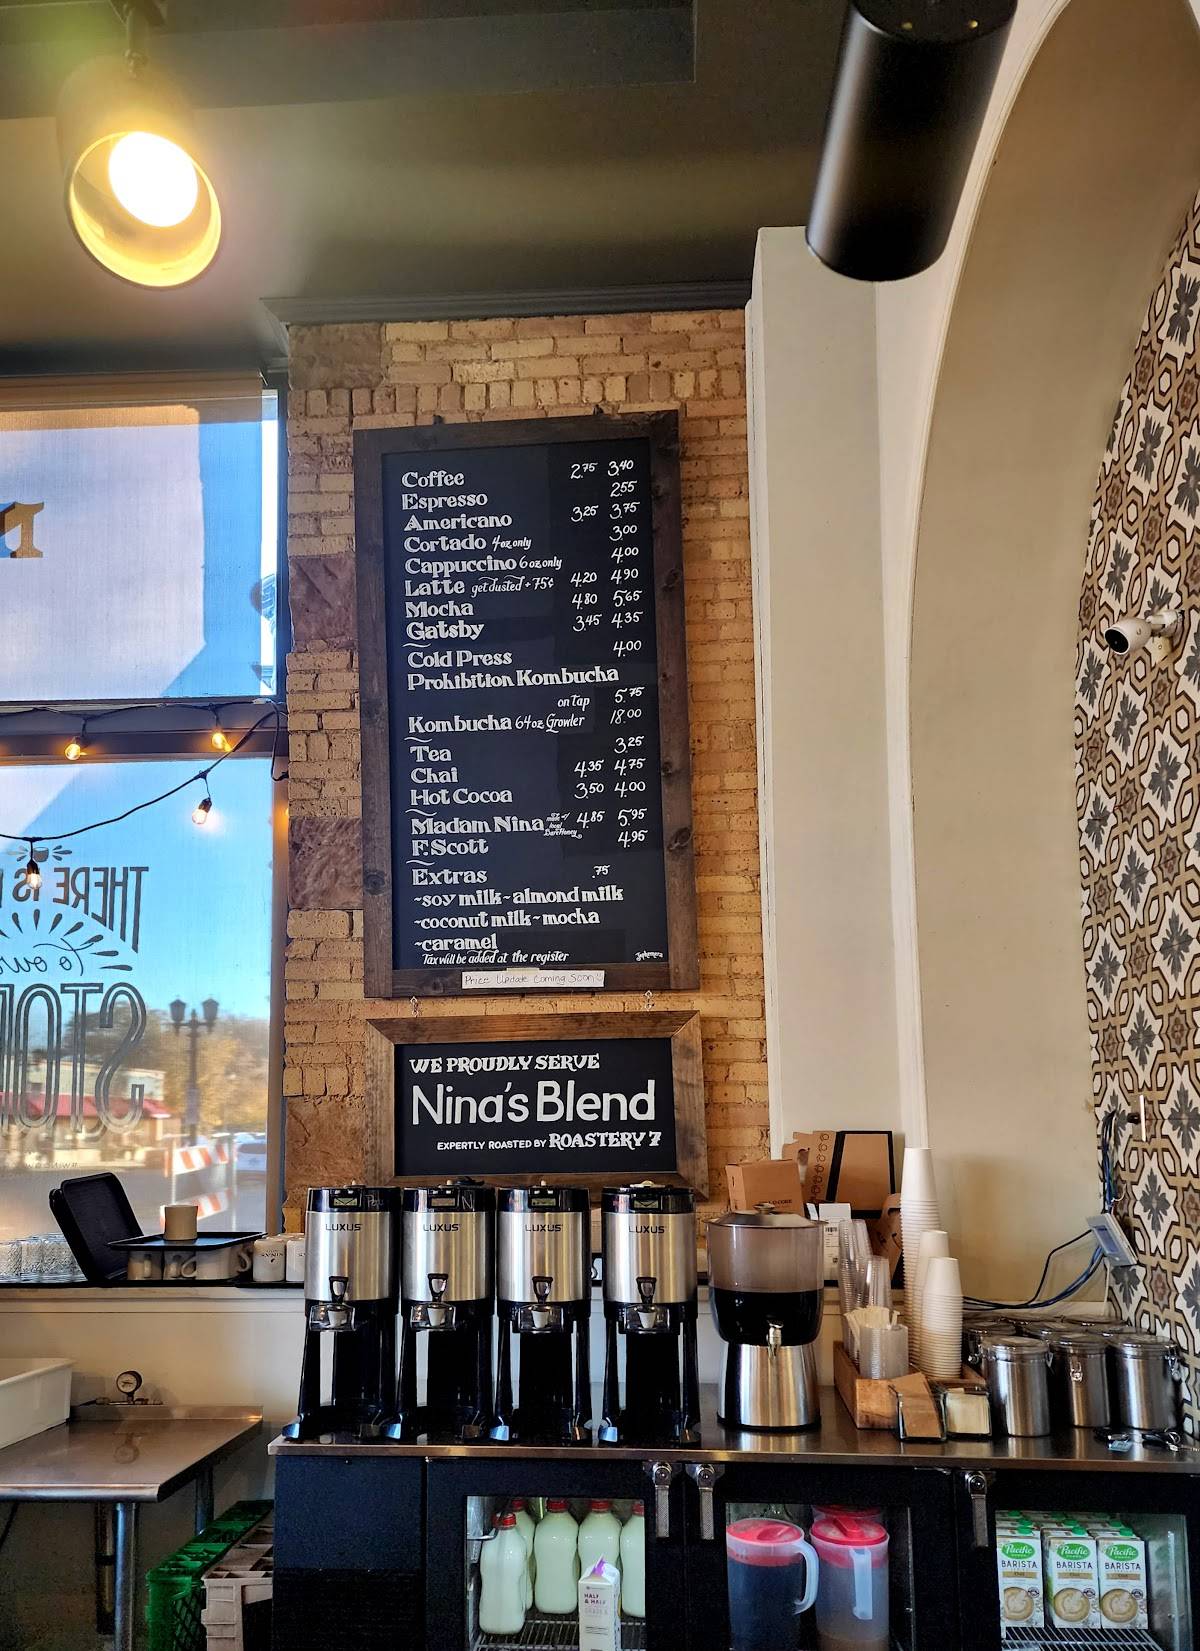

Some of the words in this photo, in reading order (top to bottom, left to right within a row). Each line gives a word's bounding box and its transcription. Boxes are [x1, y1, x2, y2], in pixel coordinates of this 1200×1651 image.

[401, 470, 465, 488] Coffee
[571, 463, 598, 479] 2.75
[608, 460, 634, 476] 3.40
[401, 493, 489, 512] Espresso
[610, 480, 638, 497] 2.55
[404, 514, 513, 531] Americano
[571, 505, 599, 522] 3.25
[610, 501, 641, 519] 3.75
[404, 534, 487, 553] Cortado
[513, 537, 532, 550] only
[608, 525, 638, 541] 3.00
[404, 555, 517, 578] Cappuccino
[542, 556, 563, 570] only
[611, 547, 639, 564] 4.00
[404, 580, 466, 597] Latte
[471, 581, 489, 598] get
[479, 575, 525, 592] dusted
[571, 571, 598, 588] 4.20
[405, 601, 474, 618] Mocha
[572, 593, 598, 610] 4.80
[613, 590, 643, 608] 5.65
[406, 620, 485, 640] Gatsby
[572, 614, 603, 632] 3.45
[611, 612, 644, 629] 4.35
[407, 651, 452, 668] Cold
[456, 650, 513, 667] Press
[613, 641, 642, 657] 4.00
[407, 671, 515, 690] Prohibition
[516, 666, 620, 687] Kombucha
[557, 698, 570, 707] on
[614, 686, 645, 703] 5.75
[408, 714, 512, 733] Kombucha
[545, 713, 585, 733] Growler
[609, 708, 642, 725] 18.00
[410, 746, 452, 762] Tea
[614, 736, 645, 753] 3.25
[410, 767, 459, 783] Chai
[574, 760, 605, 778] 4.35
[614, 758, 646, 775] 4.75
[410, 789, 450, 806] Hot
[452, 788, 513, 804] Cocoa
[575, 783, 605, 799] 3.50
[614, 781, 646, 798] 4.00
[411, 818, 492, 835] Madam
[494, 816, 544, 833] Nina
[576, 811, 606, 829] 4.85
[618, 808, 648, 826] 5.95
[411, 839, 428, 856] F.
[430, 838, 489, 855] Scott
[618, 830, 648, 848] 4.95
[412, 868, 488, 885] Extras
[458, 889, 503, 906] milk
[581, 885, 624, 902] milk
[491, 910, 532, 927] milk
[421, 953, 439, 965] Tax
[439, 953, 456, 965] will
[456, 953, 467, 965] be
[467, 950, 499, 964] added
[497, 953, 509, 964] at
[512, 950, 528, 963] the
[530, 950, 570, 966] register
[464, 975, 490, 985] Price
[496, 974, 529, 984] Update
[533, 974, 566, 986] Coming
[409, 1056, 443, 1074] WE
[446, 1055, 534, 1076] PROUDLY
[534, 1053, 600, 1072] SERVE
[412, 1081, 530, 1126] Nina's
[536, 1079, 656, 1122] Blend
[437, 1140, 486, 1151] EXPERTLY
[488, 1139, 532, 1150] ROASTED
[533, 1138, 547, 1148] BY
[549, 1131, 647, 1151] ROASTERY
[648, 1131, 662, 1147] 7
[325, 1223, 362, 1232] LUXUS
[423, 1223, 460, 1232] LUXUS
[525, 1224, 562, 1233] LUXUS
[628, 1225, 665, 1234] LUXUS
[1005, 1543, 1033, 1555] Pacific
[1060, 1545, 1088, 1556] Pacific
[1109, 1546, 1137, 1557] Pacific
[1001, 1560, 1038, 1568] BARISTA
[1056, 1561, 1093, 1570] BARISTA
[1104, 1562, 1141, 1571] BARISTA
